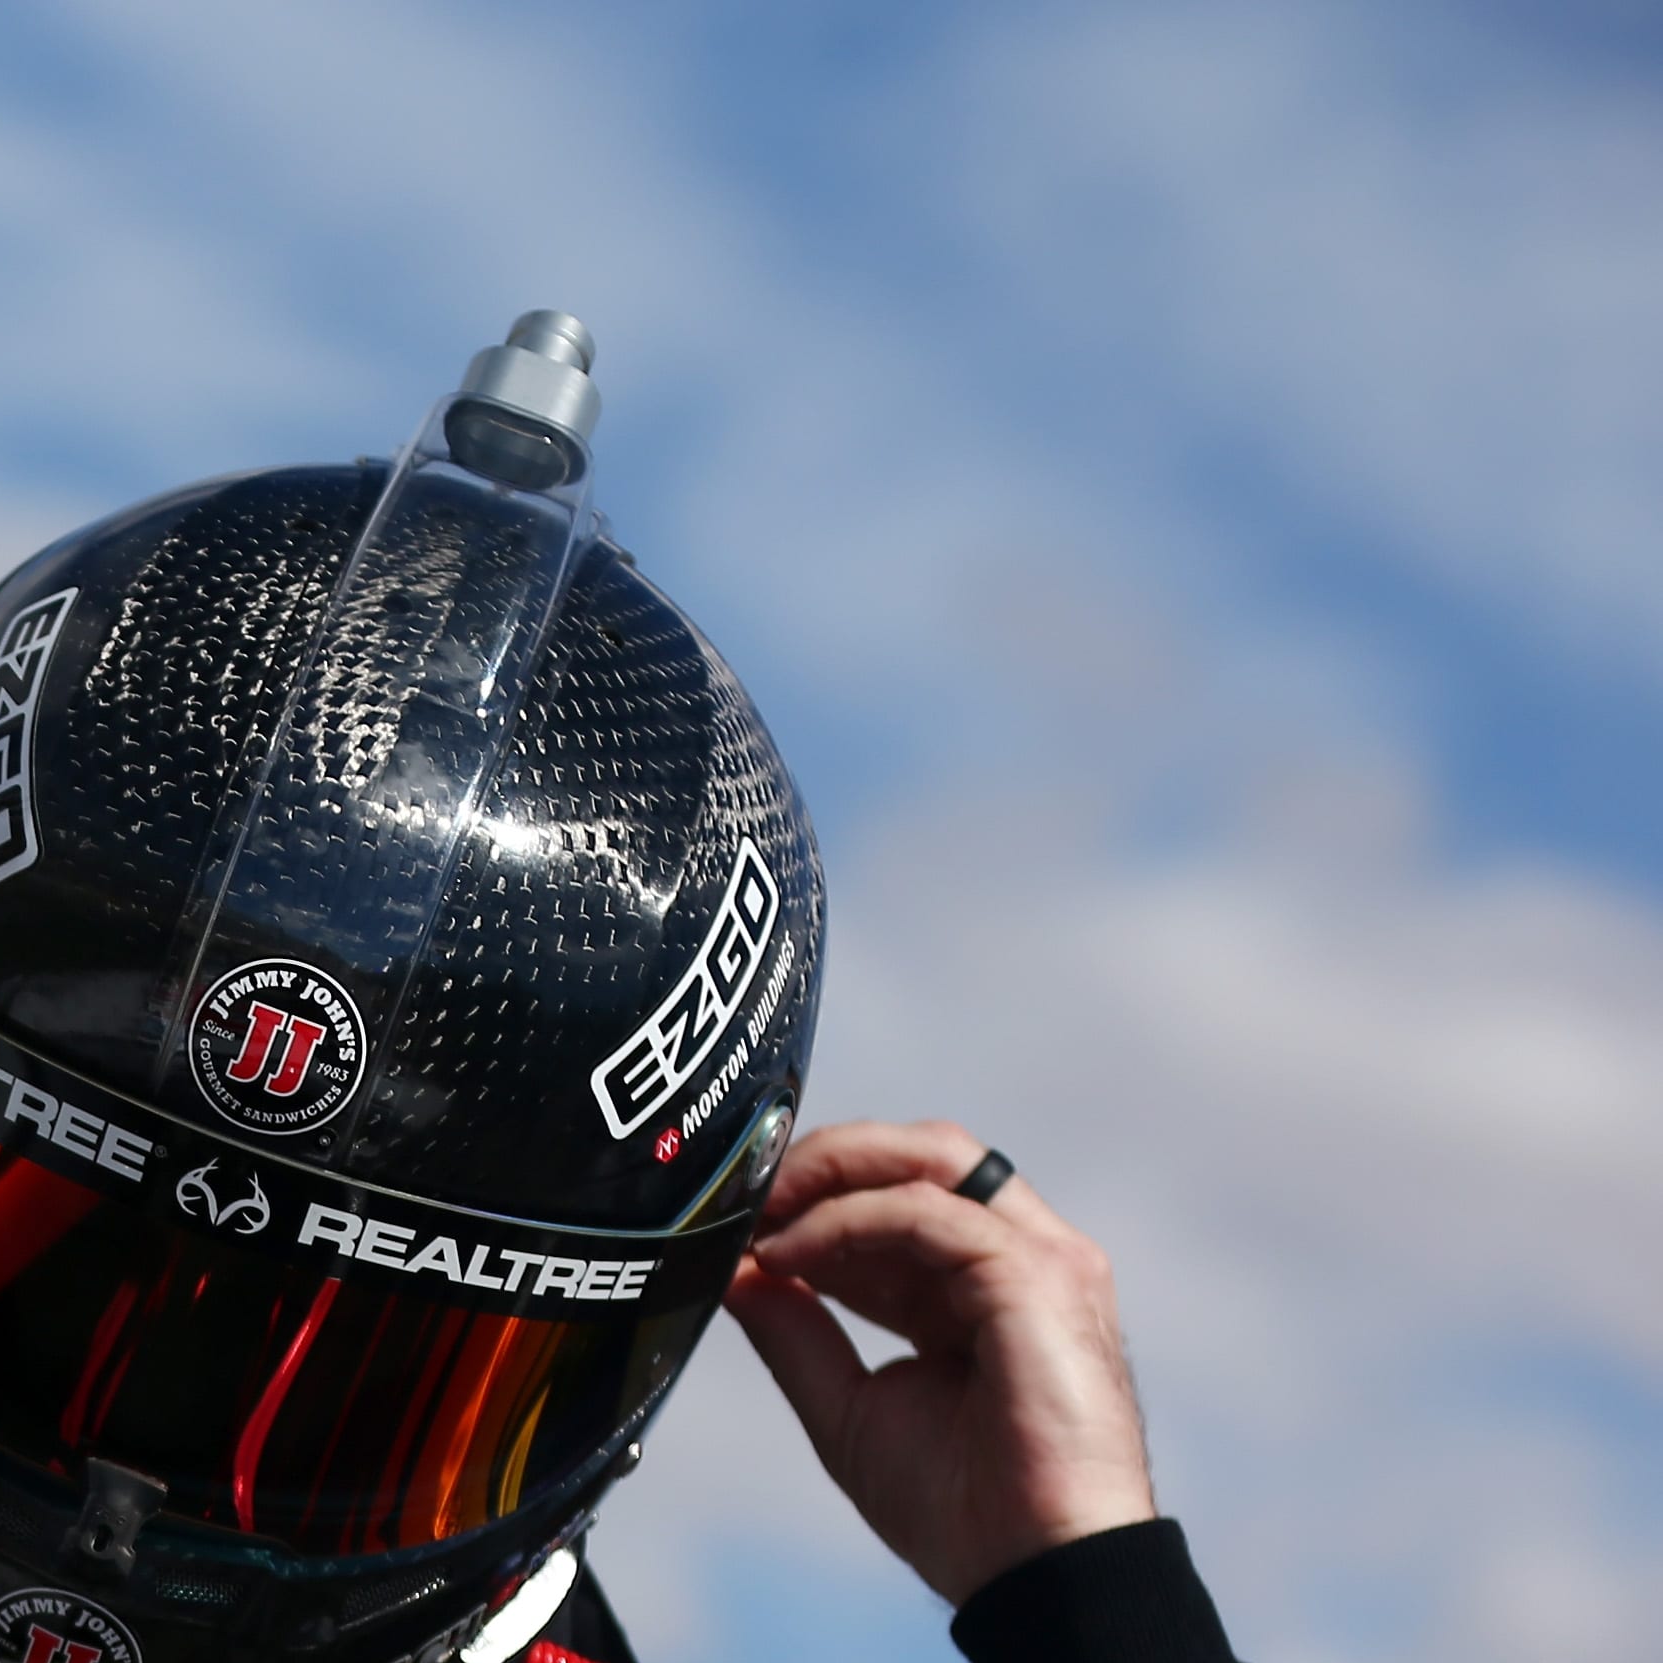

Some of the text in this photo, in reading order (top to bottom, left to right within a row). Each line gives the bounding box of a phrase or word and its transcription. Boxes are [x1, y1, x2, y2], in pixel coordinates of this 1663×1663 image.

[201, 1019, 237, 1042] Since
[209, 970, 356, 1062] JIMMY JOHN'S
[602, 850, 774, 1128] EZGO
[682, 1038, 748, 1140] MORTON
[747, 929, 796, 1049] BUILDINGS
[199, 1037, 343, 1124] GOURMET SANDWICHES
[225, 1000, 328, 1098] JJ
[316, 1062, 350, 1082] 1983
[297, 1202, 656, 1301] REALTREE
